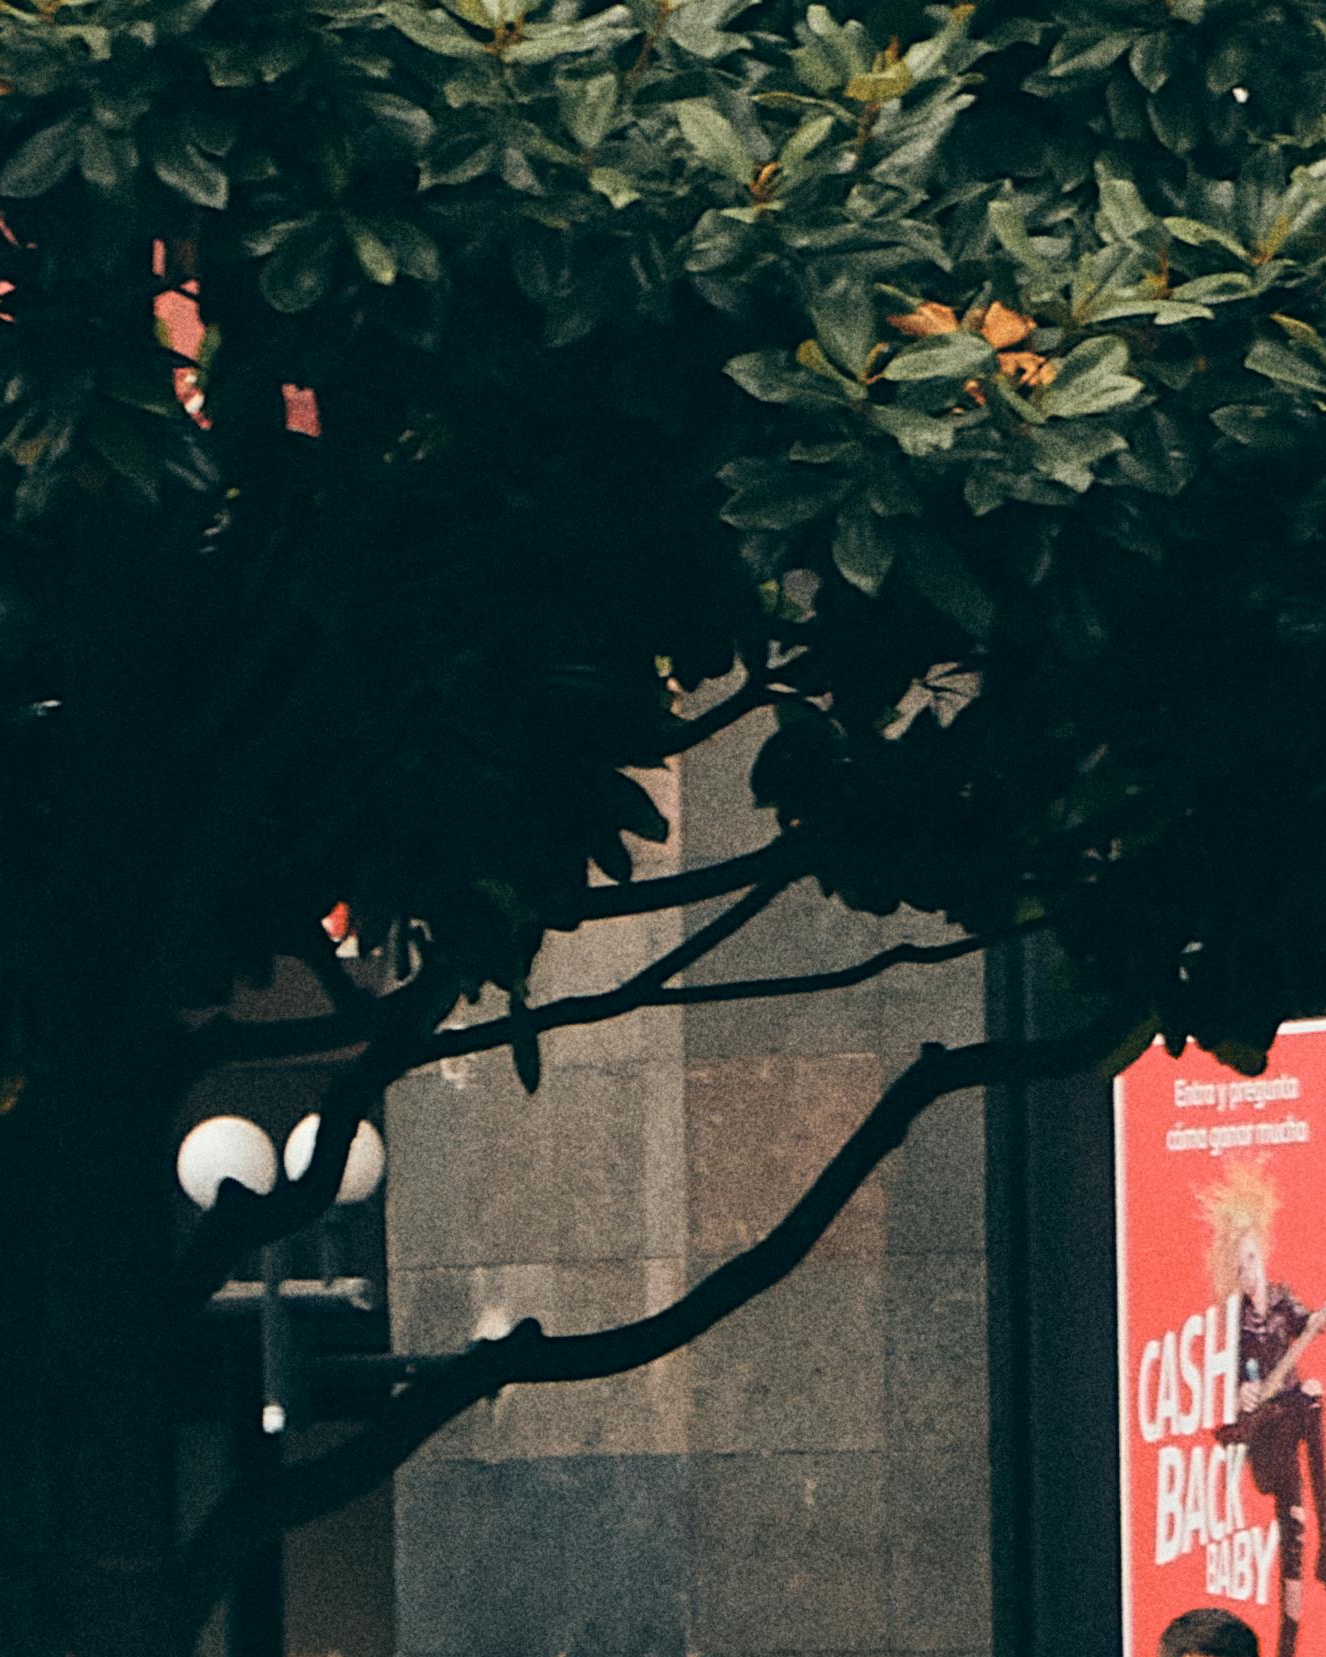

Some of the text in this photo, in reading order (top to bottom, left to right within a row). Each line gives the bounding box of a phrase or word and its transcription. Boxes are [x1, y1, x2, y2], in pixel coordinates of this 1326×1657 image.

[1137, 1294, 1239, 1443] CASH
[1155, 1443, 1246, 1566] BACK
[1205, 1520, 1280, 1606] BABY
